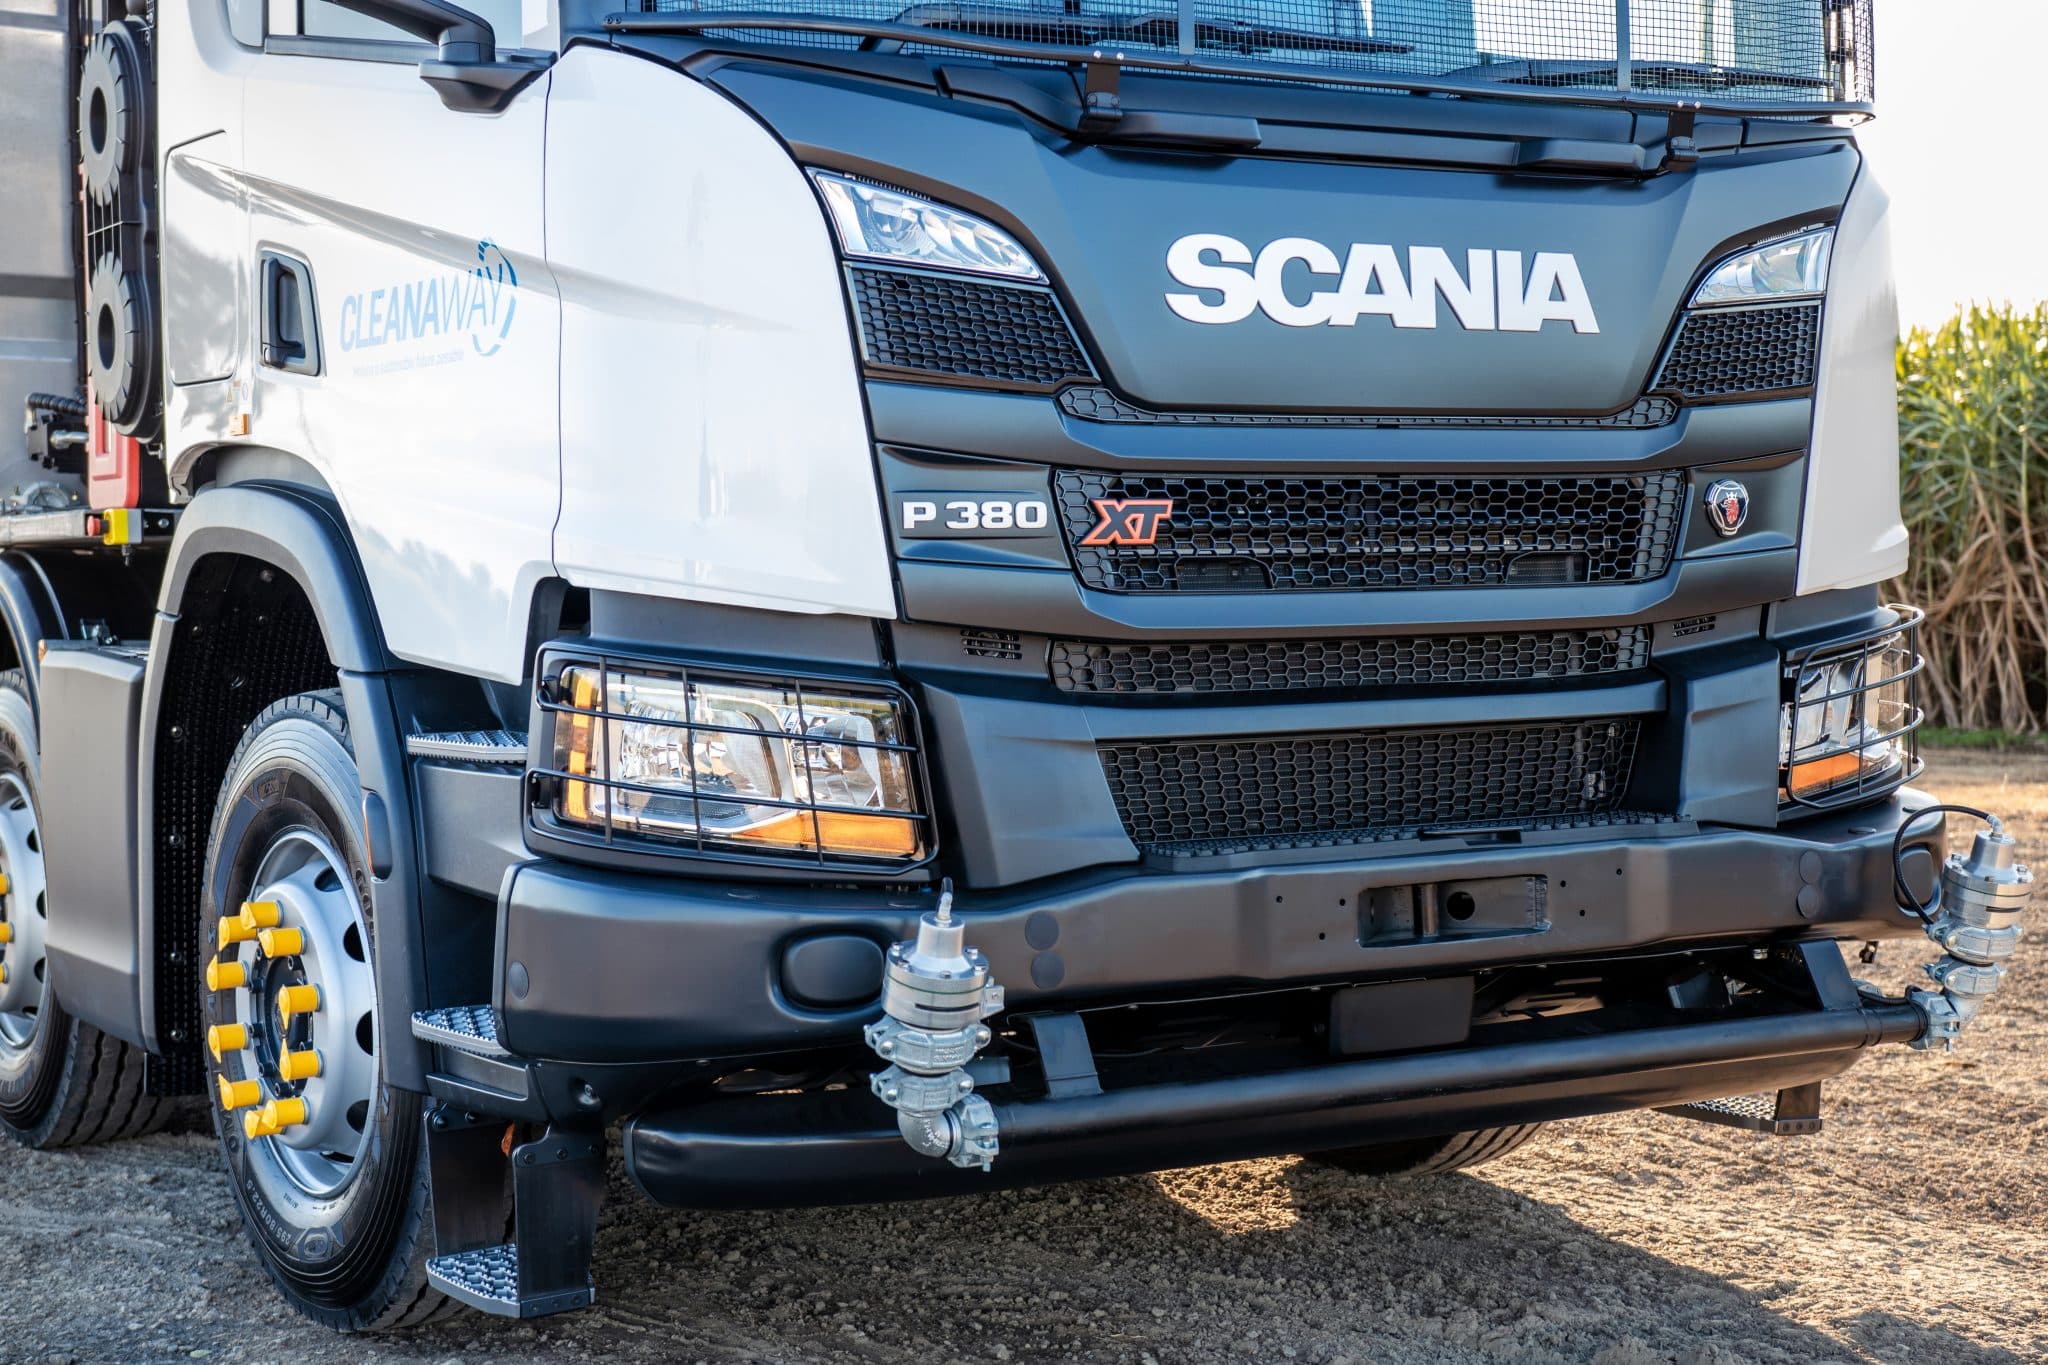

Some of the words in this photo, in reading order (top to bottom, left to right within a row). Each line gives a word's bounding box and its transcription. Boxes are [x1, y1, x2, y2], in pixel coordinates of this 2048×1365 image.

[340, 263, 503, 352] CLEANAWAY
[1164, 233, 1600, 334] SCANIA
[903, 501, 936, 529] P
[945, 501, 1047, 529] 380
[1078, 499, 1172, 545] XT
